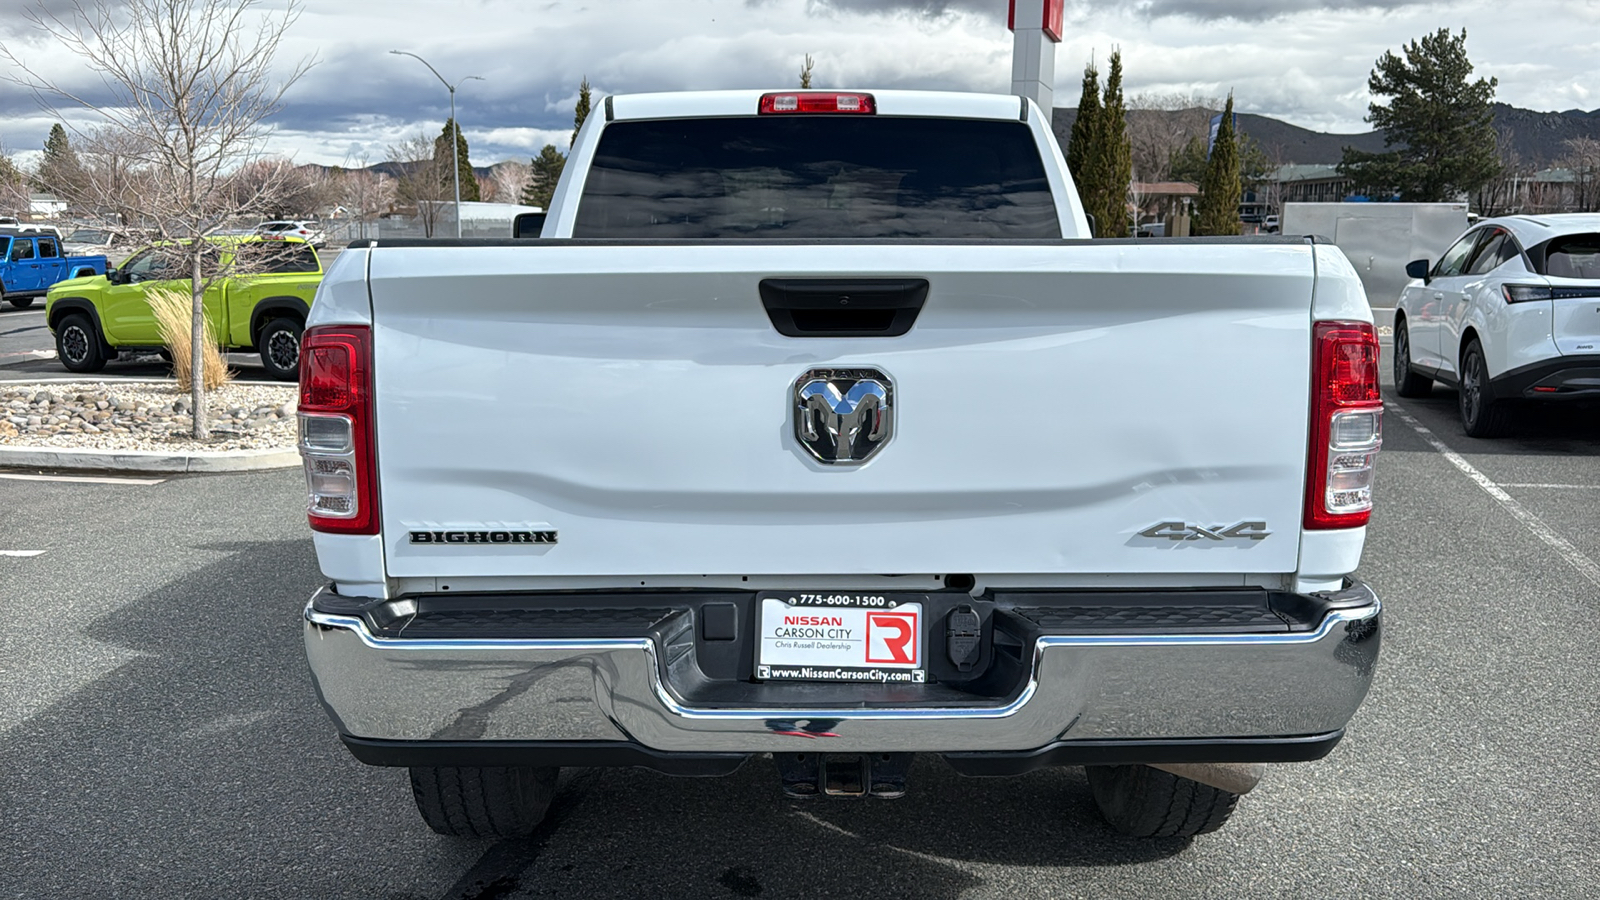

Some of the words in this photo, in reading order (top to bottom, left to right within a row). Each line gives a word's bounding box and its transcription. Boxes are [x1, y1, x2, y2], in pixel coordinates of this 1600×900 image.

[813, 369, 873, 378] RAM
[409, 530, 558, 544] BIGHORN
[800, 594, 885, 607] 775-600-1500
[784, 616, 843, 626] NISSAN
[774, 627, 824, 638] CARSON
[827, 628, 852, 639] CITY
[775, 640, 792, 648] Chris
[793, 641, 815, 649] Russell
[816, 641, 852, 651] Dealership
[871, 616, 912, 663] R
[771, 667, 911, 683] www.NissanCarsonCity.com
